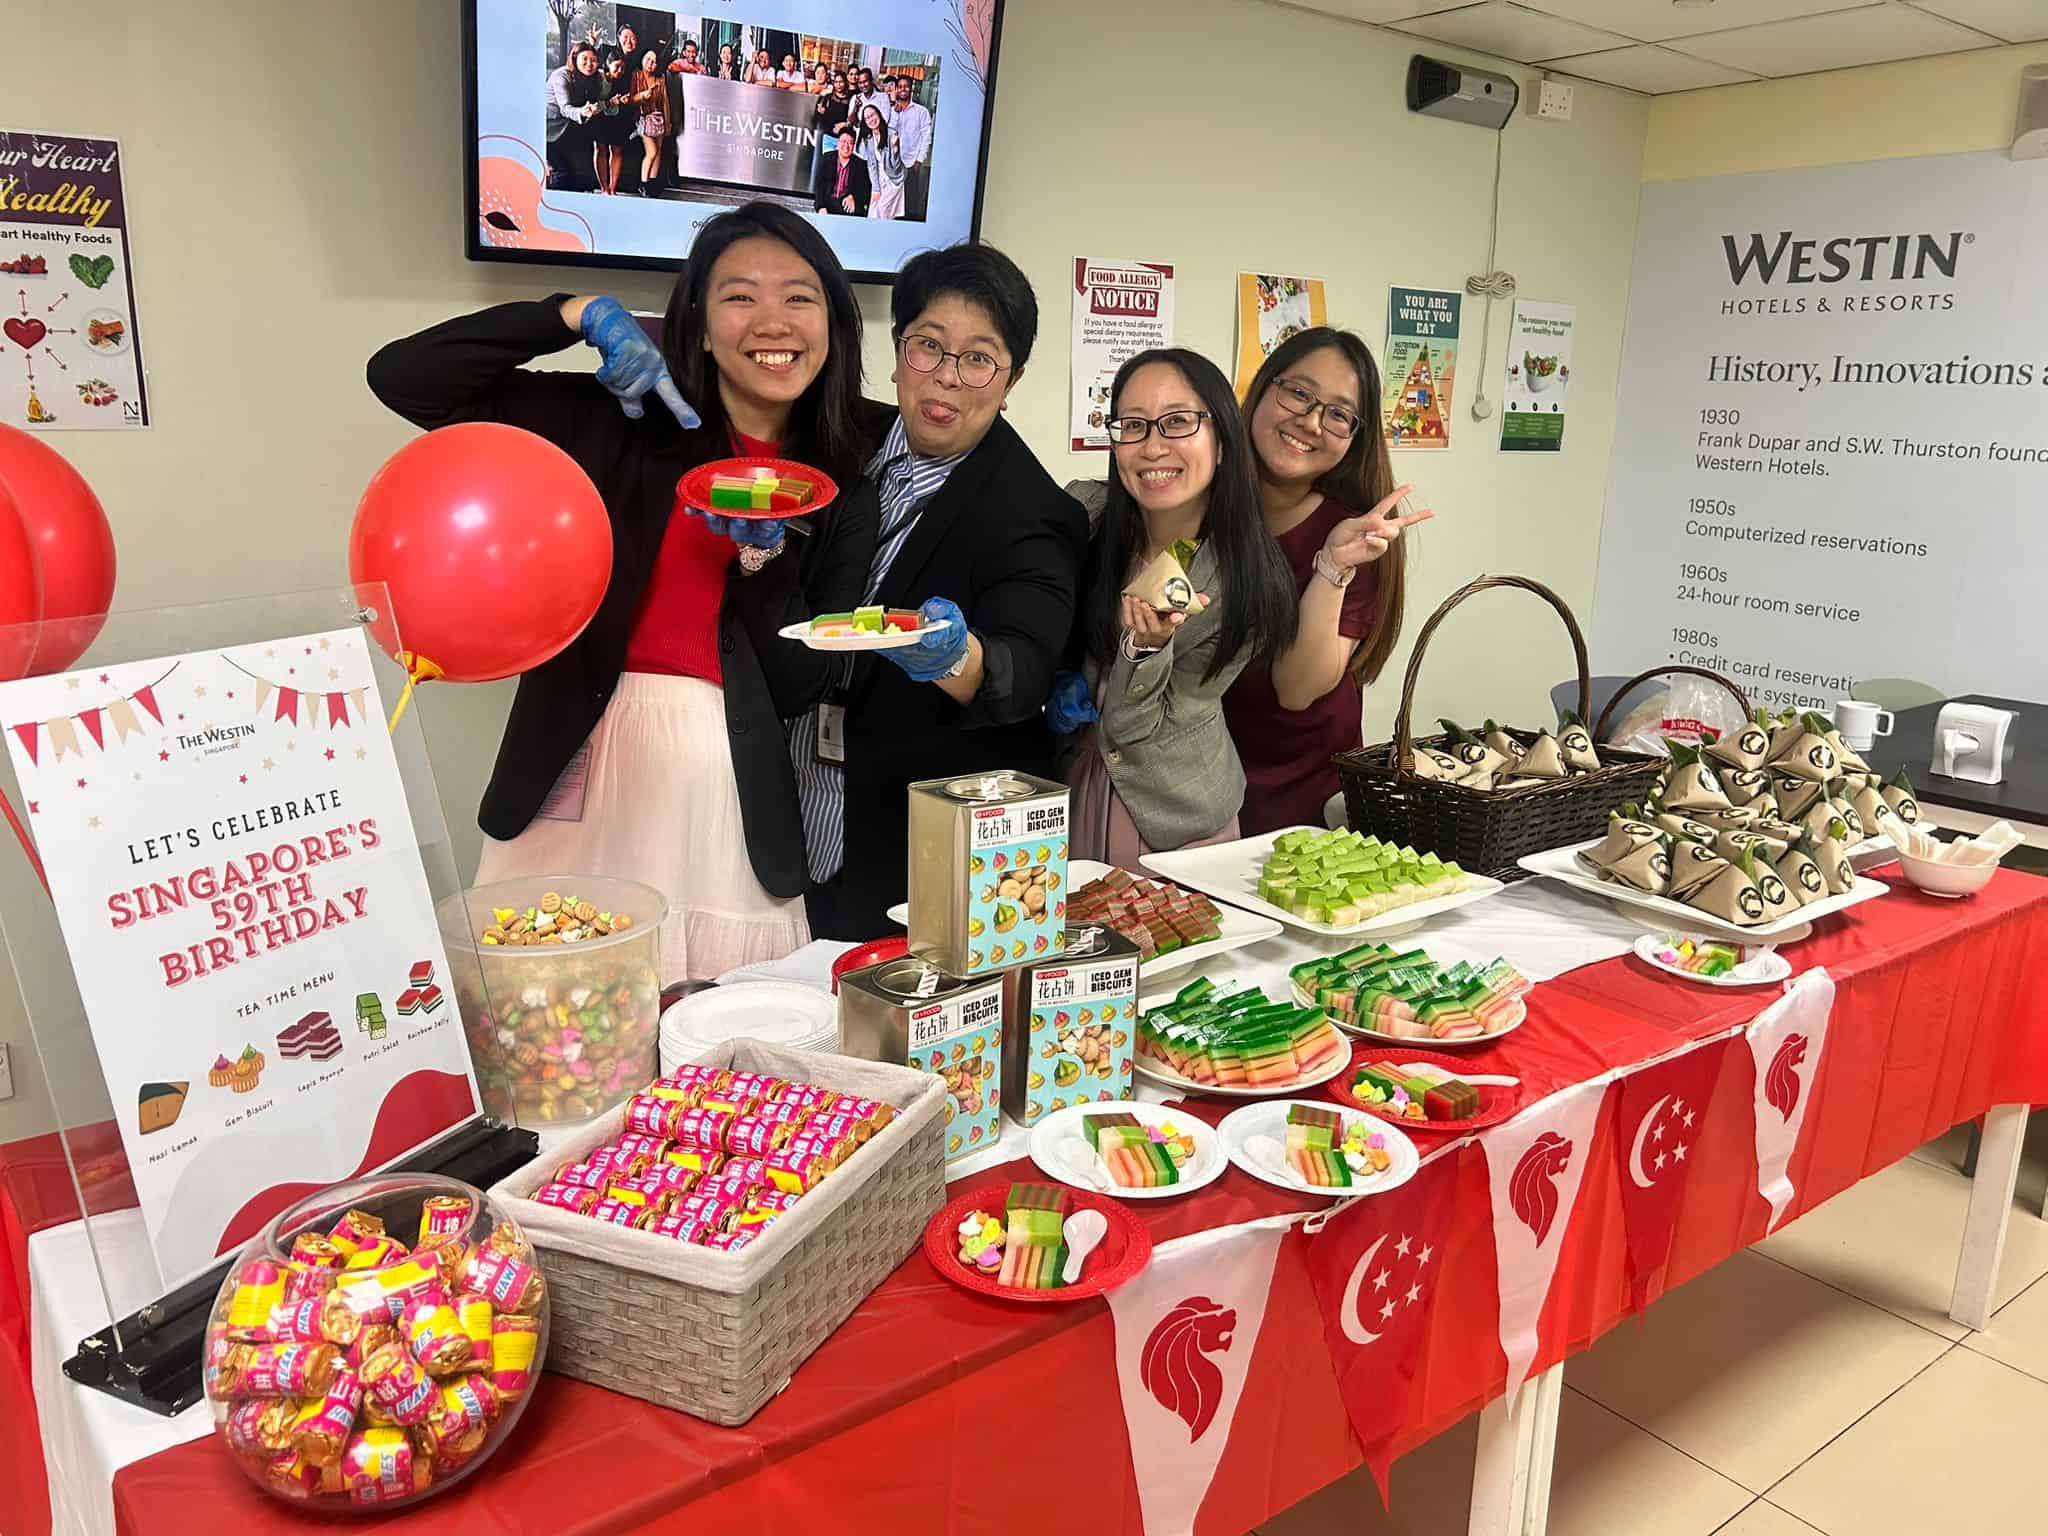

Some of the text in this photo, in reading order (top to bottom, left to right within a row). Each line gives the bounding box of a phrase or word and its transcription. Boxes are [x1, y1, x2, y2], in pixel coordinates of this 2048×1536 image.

[735, 112, 819, 147] WESTIN
[32, 142, 116, 173] Heart
[22, 230, 71, 244] Healthy
[75, 233, 112, 244] Foods
[1090, 271, 1160, 287] FOOD ALLERGY
[1093, 288, 1155, 310] NOTICE
[1405, 295, 1448, 309] YOU ARE
[1721, 294, 1954, 315] HOTELS & RESORTS
[1091, 319, 1102, 327] you
[1103, 319, 1117, 327] have
[1124, 320, 1136, 328] food
[1400, 308, 1453, 323] WHAT YOU
[1416, 323, 1437, 335] EAT
[1707, 355, 1822, 393] History,
[1831, 354, 2034, 386] Innovations
[1700, 408, 1740, 425] 1930
[1698, 431, 1743, 449] Frank
[1748, 434, 1800, 453] Dupar
[1805, 436, 1840, 453] and
[1847, 437, 1885, 455] S.W.
[1892, 438, 1981, 460] Thurston
[1695, 454, 1830, 477] Western Hotels.
[1688, 498, 1736, 516] 1950s
[1685, 520, 1928, 557] Computerized reservations
[1680, 563, 1728, 583] 1960s
[1677, 585, 1861, 622] 24-hour room service
[1672, 628, 1719, 648] 1980s
[1679, 650, 1729, 672] Credit
[1733, 662, 1770, 679] card
[1764, 688, 1826, 709] system
[176, 723, 256, 750] THE WESTIN
[1027, 806, 1064, 821] ICED GEM
[1027, 816, 1065, 832] BISCUITS
[128, 788, 343, 865] LET'S CELEBRATE
[107, 818, 381, 930] SINGAPORE'S
[210, 872, 315, 931] 59TH
[159, 887, 369, 987] BIRTHDAY
[1091, 967, 1132, 982] ICED GEM
[237, 971, 335, 1018] TEA TIME MENU
[1091, 978, 1132, 993] BISCUITS
[963, 993, 999, 1014] ICED GEM
[963, 1004, 999, 1025] BISCUITS
[225, 1099, 273, 1128] Gem Biscuit
[149, 1135, 198, 1164] Nasi Lemak
[493, 1265, 516, 1301] HAW
